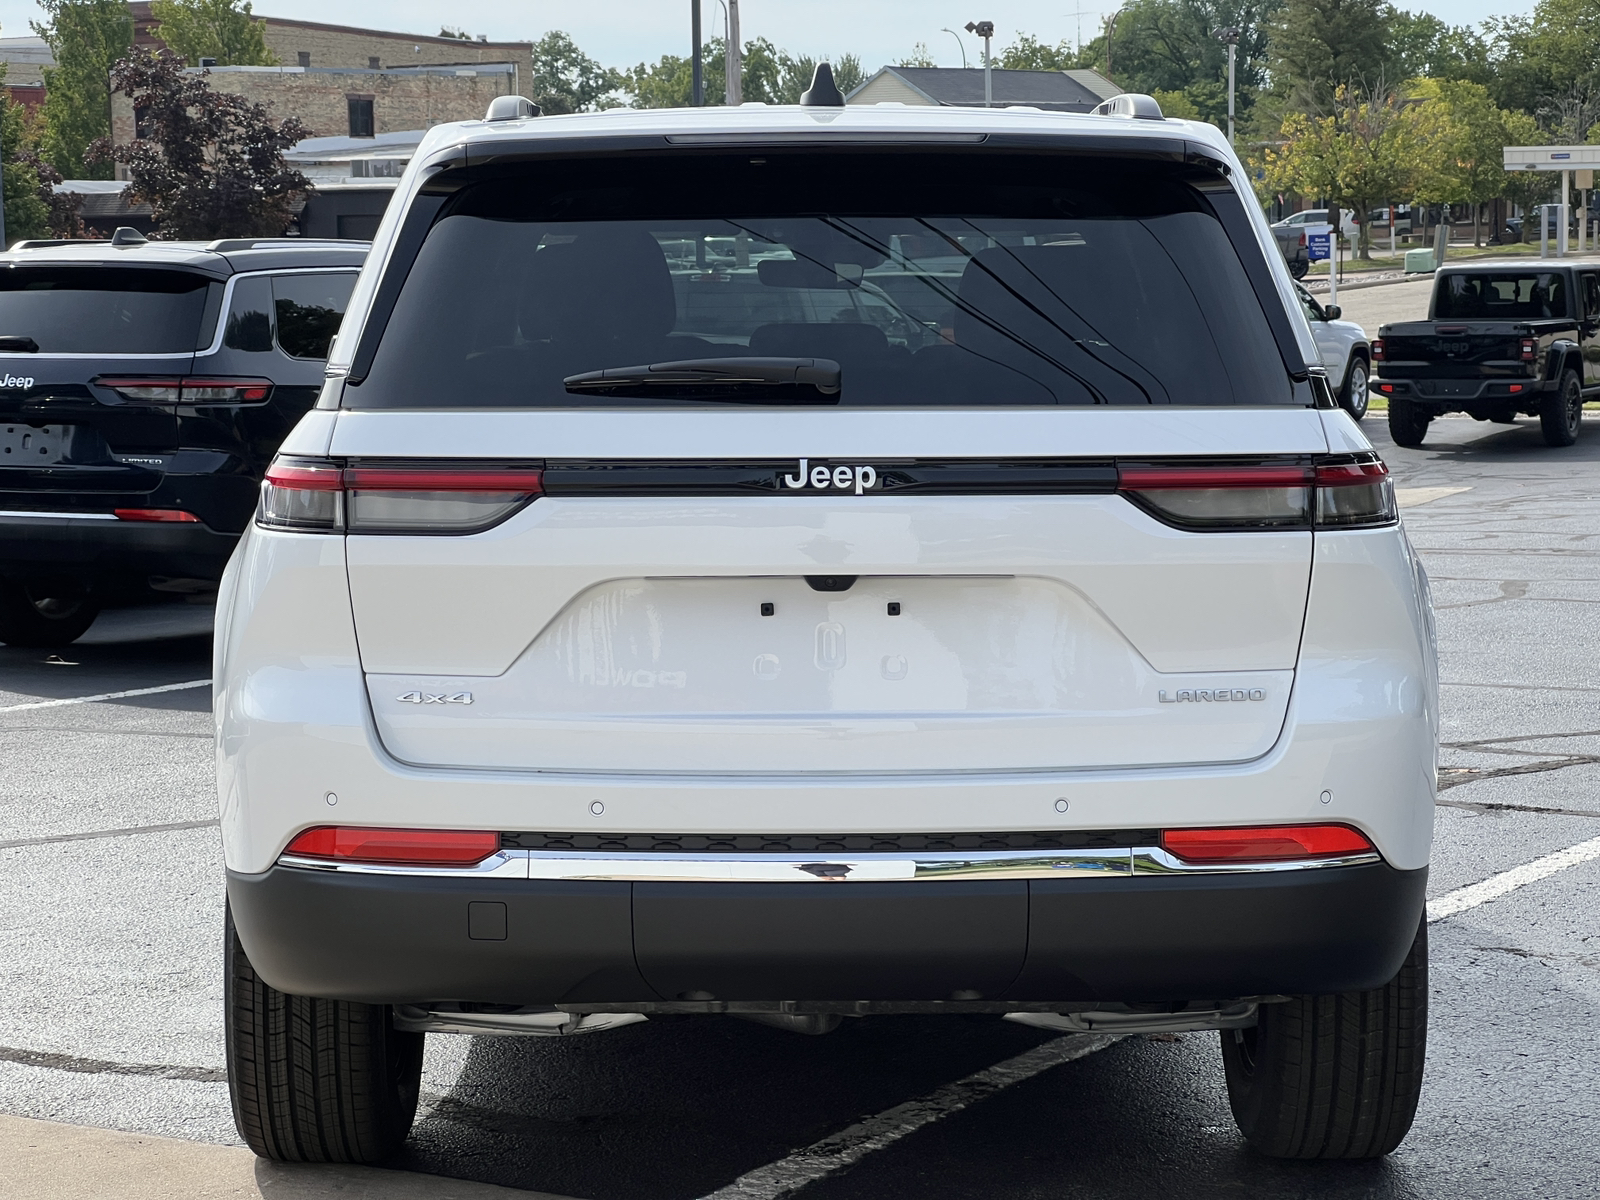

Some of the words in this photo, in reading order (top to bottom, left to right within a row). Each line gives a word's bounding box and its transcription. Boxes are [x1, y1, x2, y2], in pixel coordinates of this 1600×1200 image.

[1429, 339, 1469, 355] Jeep
[0, 373, 35, 390] Jeep
[784, 458, 877, 495] Jeep
[395, 690, 475, 705] 4x4
[1158, 687, 1267, 703] LAREDO
